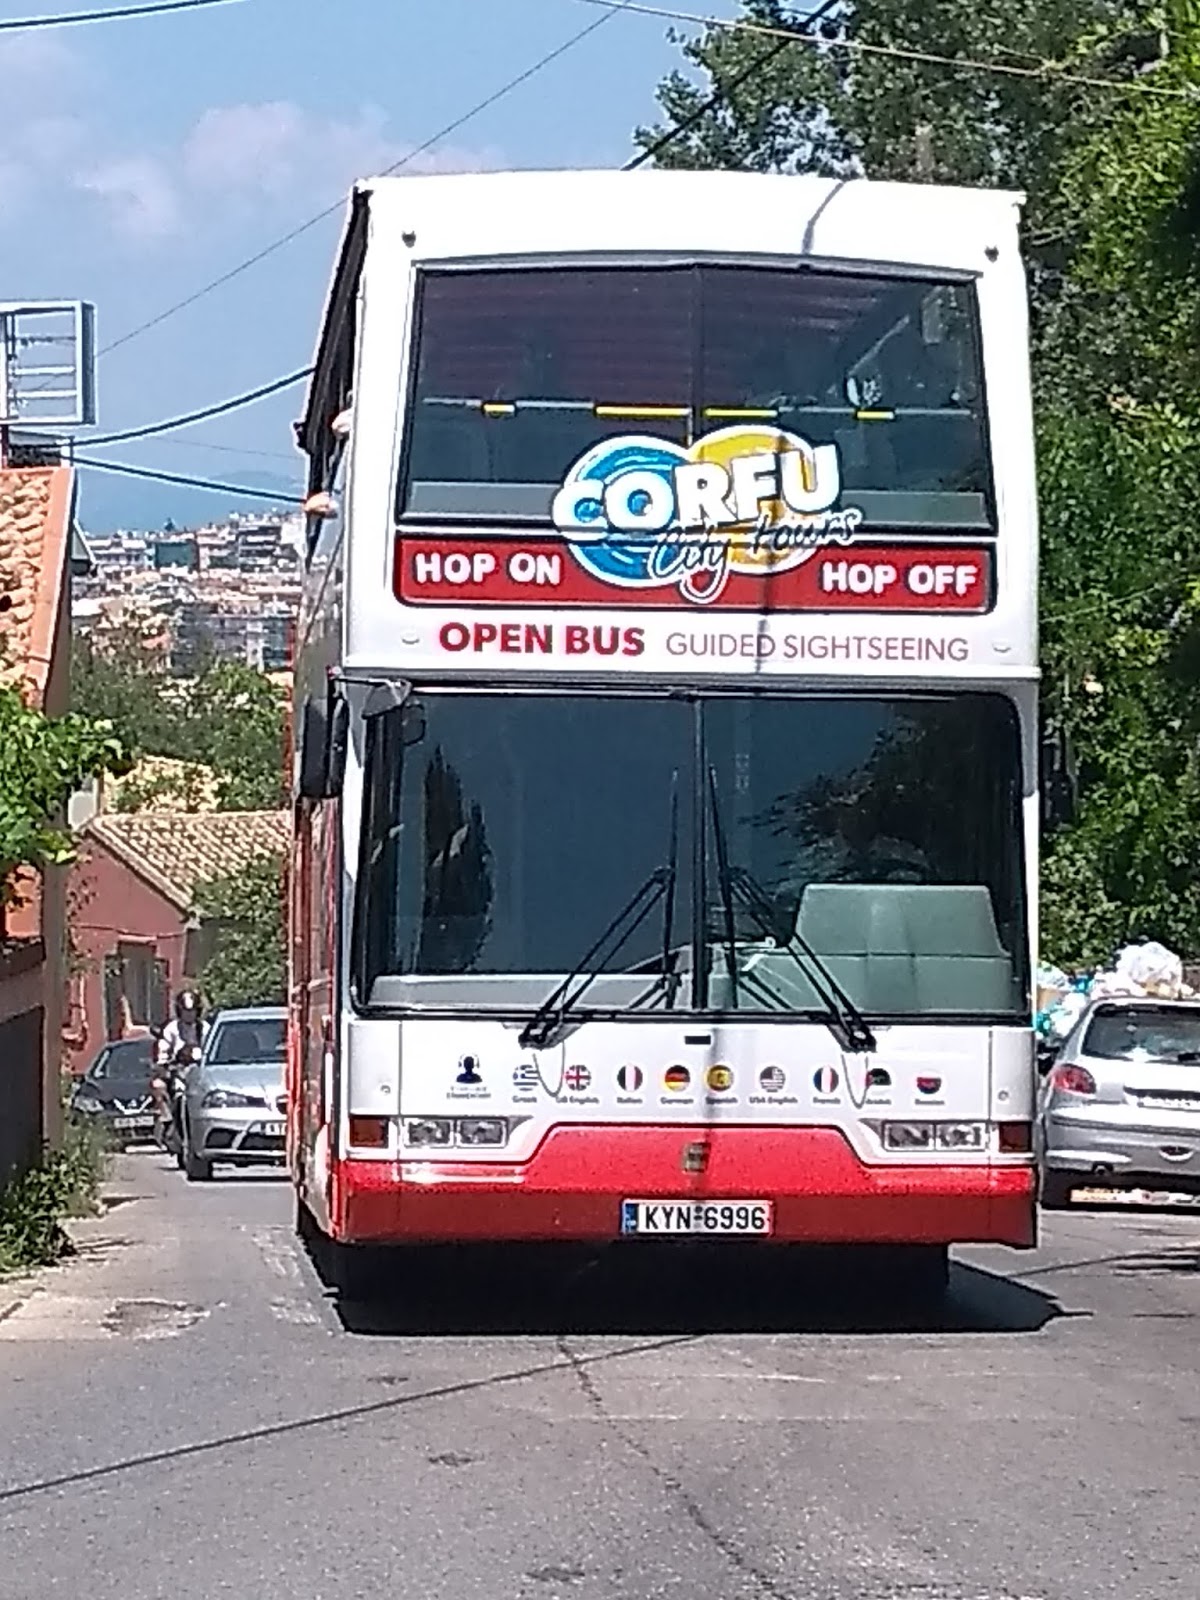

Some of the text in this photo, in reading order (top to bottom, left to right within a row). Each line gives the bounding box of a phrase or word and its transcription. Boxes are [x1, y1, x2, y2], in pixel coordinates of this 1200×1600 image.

[552, 444, 839, 541] CORFU
[415, 553, 561, 586] HOP ON
[652, 522, 731, 600] City
[822, 561, 979, 596] HOP OFF
[439, 621, 645, 657] OPEN BUS
[666, 632, 970, 662] GUIDED SIGHTSEEING
